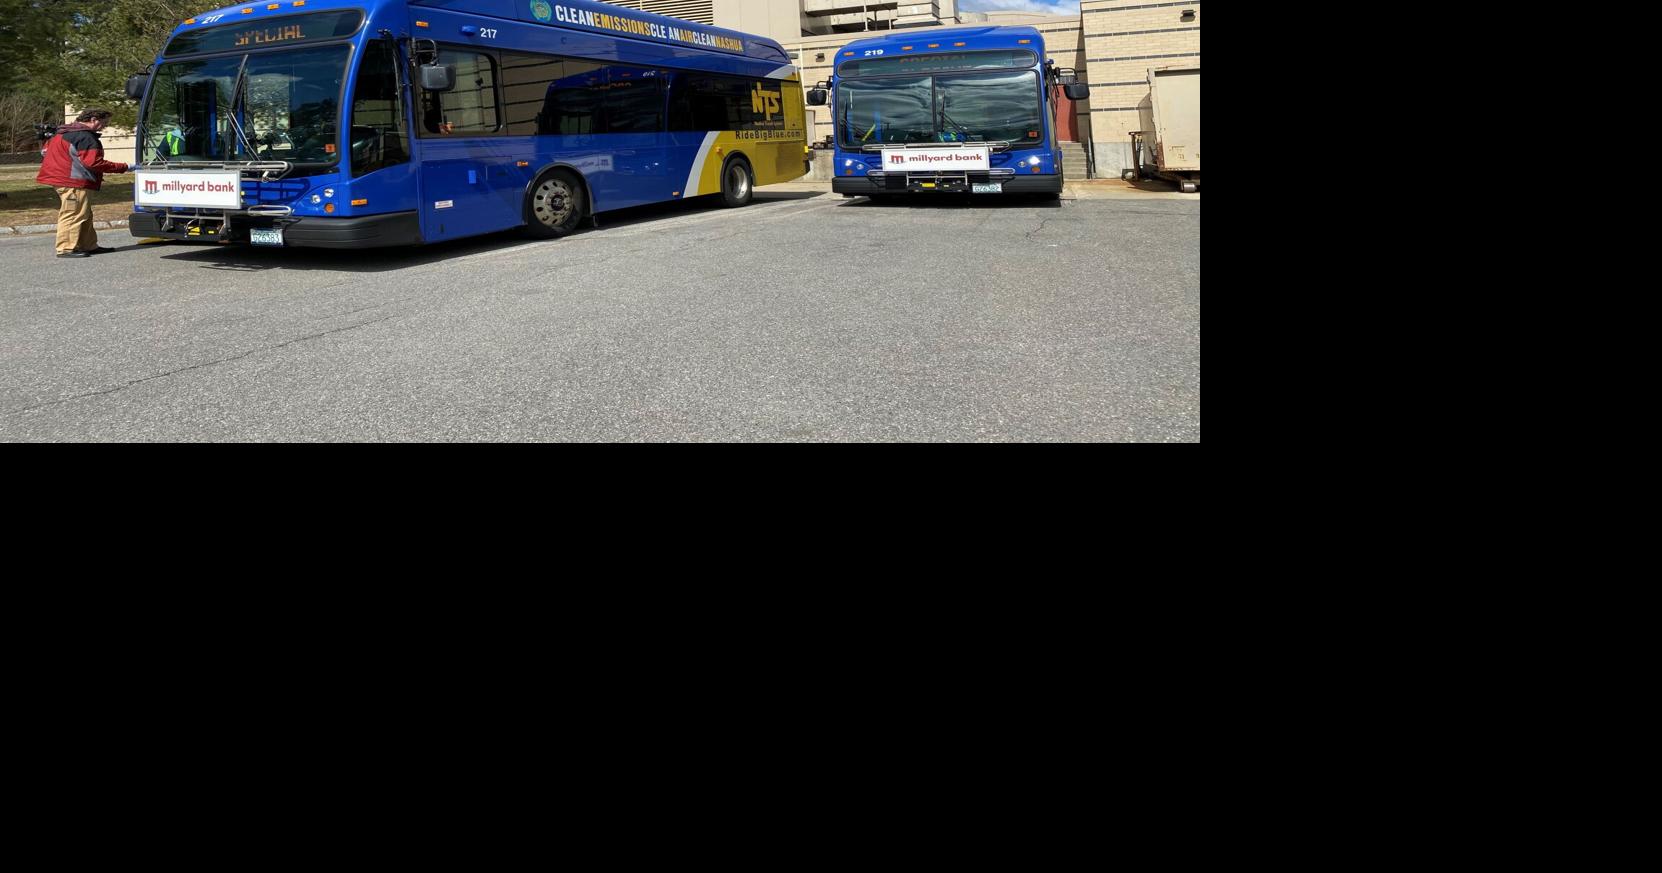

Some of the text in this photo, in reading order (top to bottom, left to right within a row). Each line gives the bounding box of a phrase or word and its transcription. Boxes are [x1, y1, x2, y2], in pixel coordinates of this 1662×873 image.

[201, 14, 224, 24] 217
[480, 27, 497, 39] 217
[751, 81, 780, 121] NTS
[735, 130, 801, 140] RideBigBlue.com
[909, 154, 953, 163] millyard
[162, 181, 206, 194] millyard
[207, 181, 235, 193] bank
